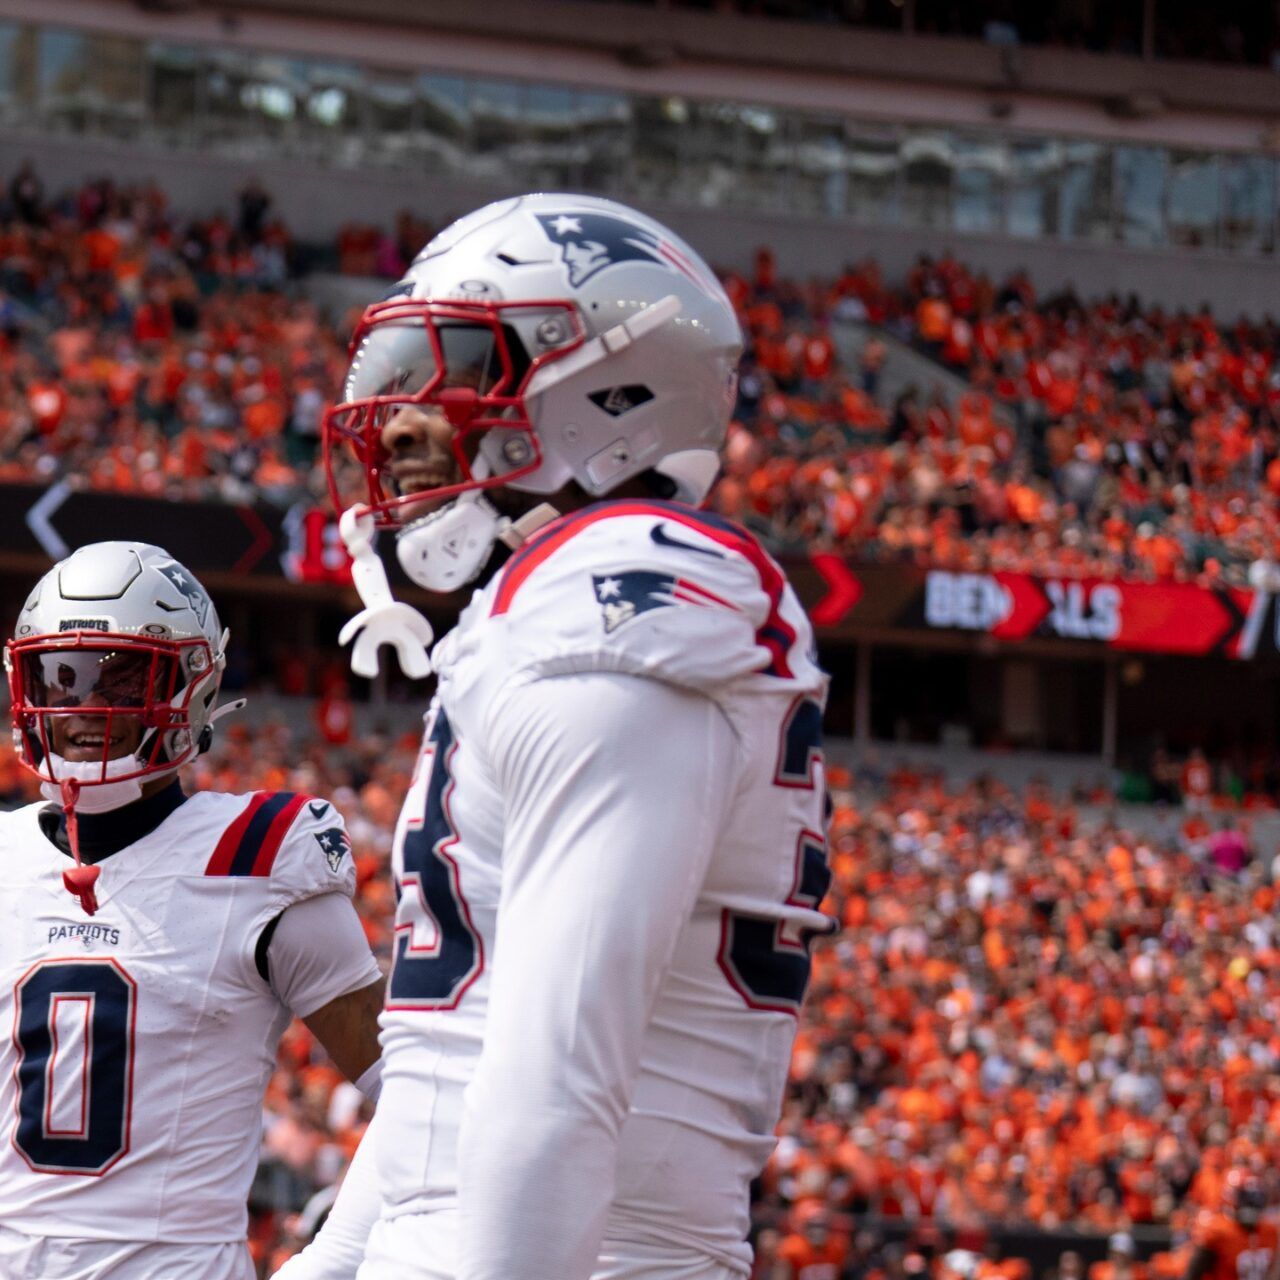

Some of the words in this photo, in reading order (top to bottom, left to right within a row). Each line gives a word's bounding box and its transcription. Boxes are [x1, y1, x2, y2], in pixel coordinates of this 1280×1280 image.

[59, 618, 110, 632] PATRIOTS
[48, 924, 120, 946] PATRIOTS
[9, 956, 139, 1177] 0
